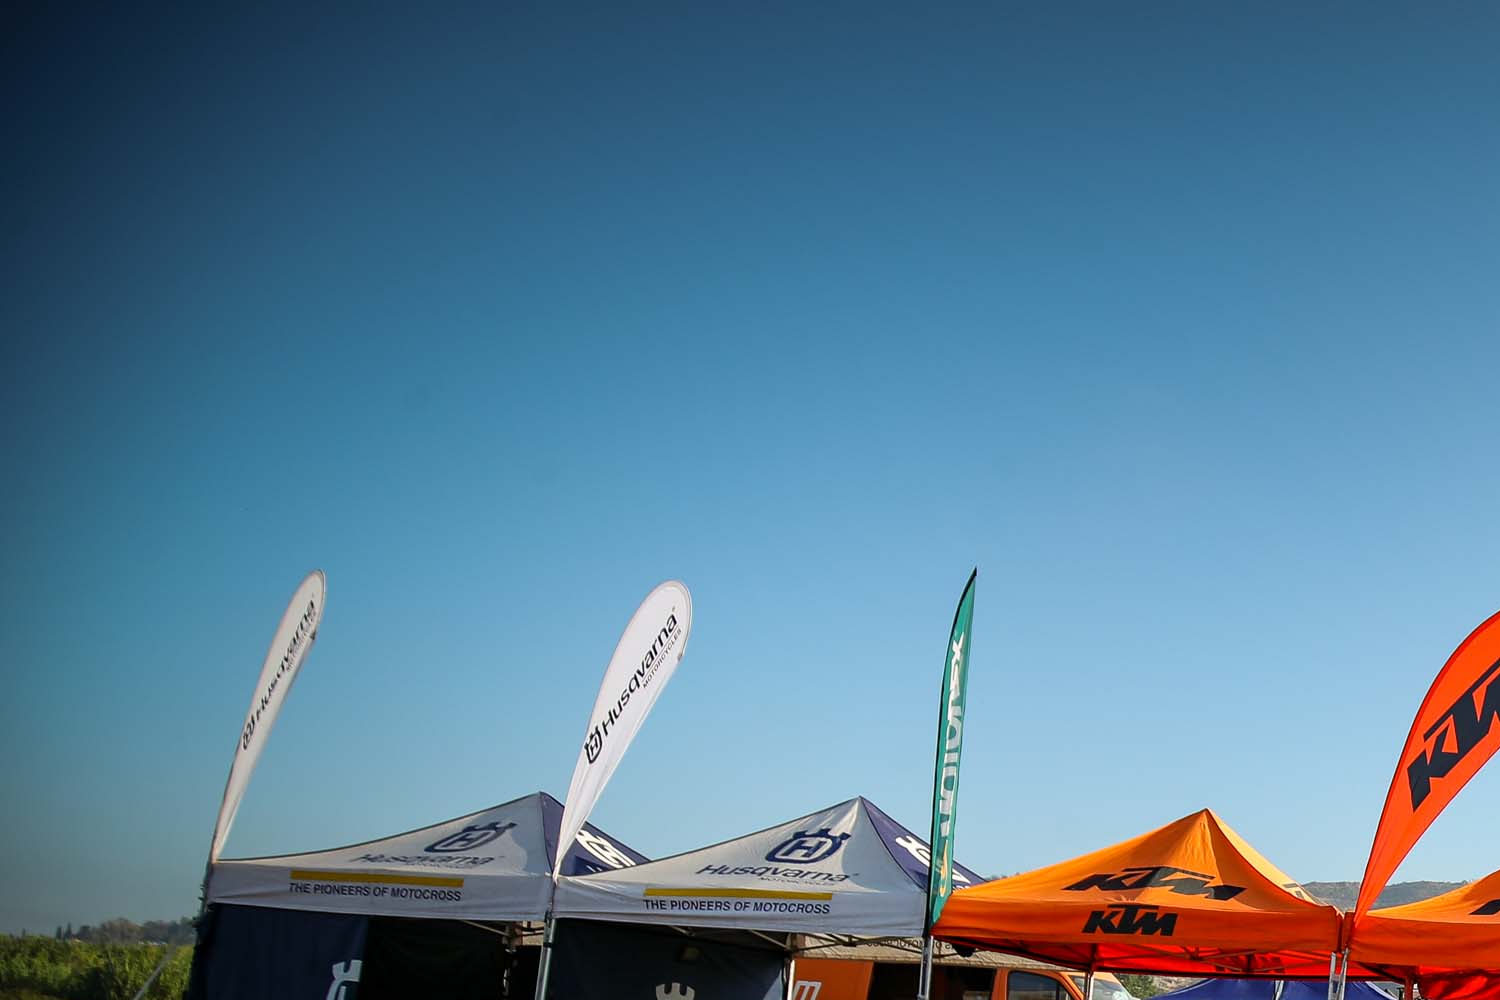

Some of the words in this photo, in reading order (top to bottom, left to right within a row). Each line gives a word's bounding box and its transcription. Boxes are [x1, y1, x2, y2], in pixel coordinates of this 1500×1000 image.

[643, 628, 682, 688] MOTORCYCLES
[602, 613, 678, 737] Husqvarna
[696, 863, 849, 883] Husqvarna
[1060, 866, 1247, 900] KTM
[289, 883, 311, 894] THE
[313, 884, 369, 897] PIONEERS
[373, 886, 390, 897] OF
[390, 887, 461, 901] MOTOCROSS
[643, 899, 669, 911] THE
[670, 900, 730, 912] PIONEERS
[734, 901, 750, 912] OF
[753, 901, 830, 915] MOTOCROSS
[1081, 904, 1178, 936] KTM
